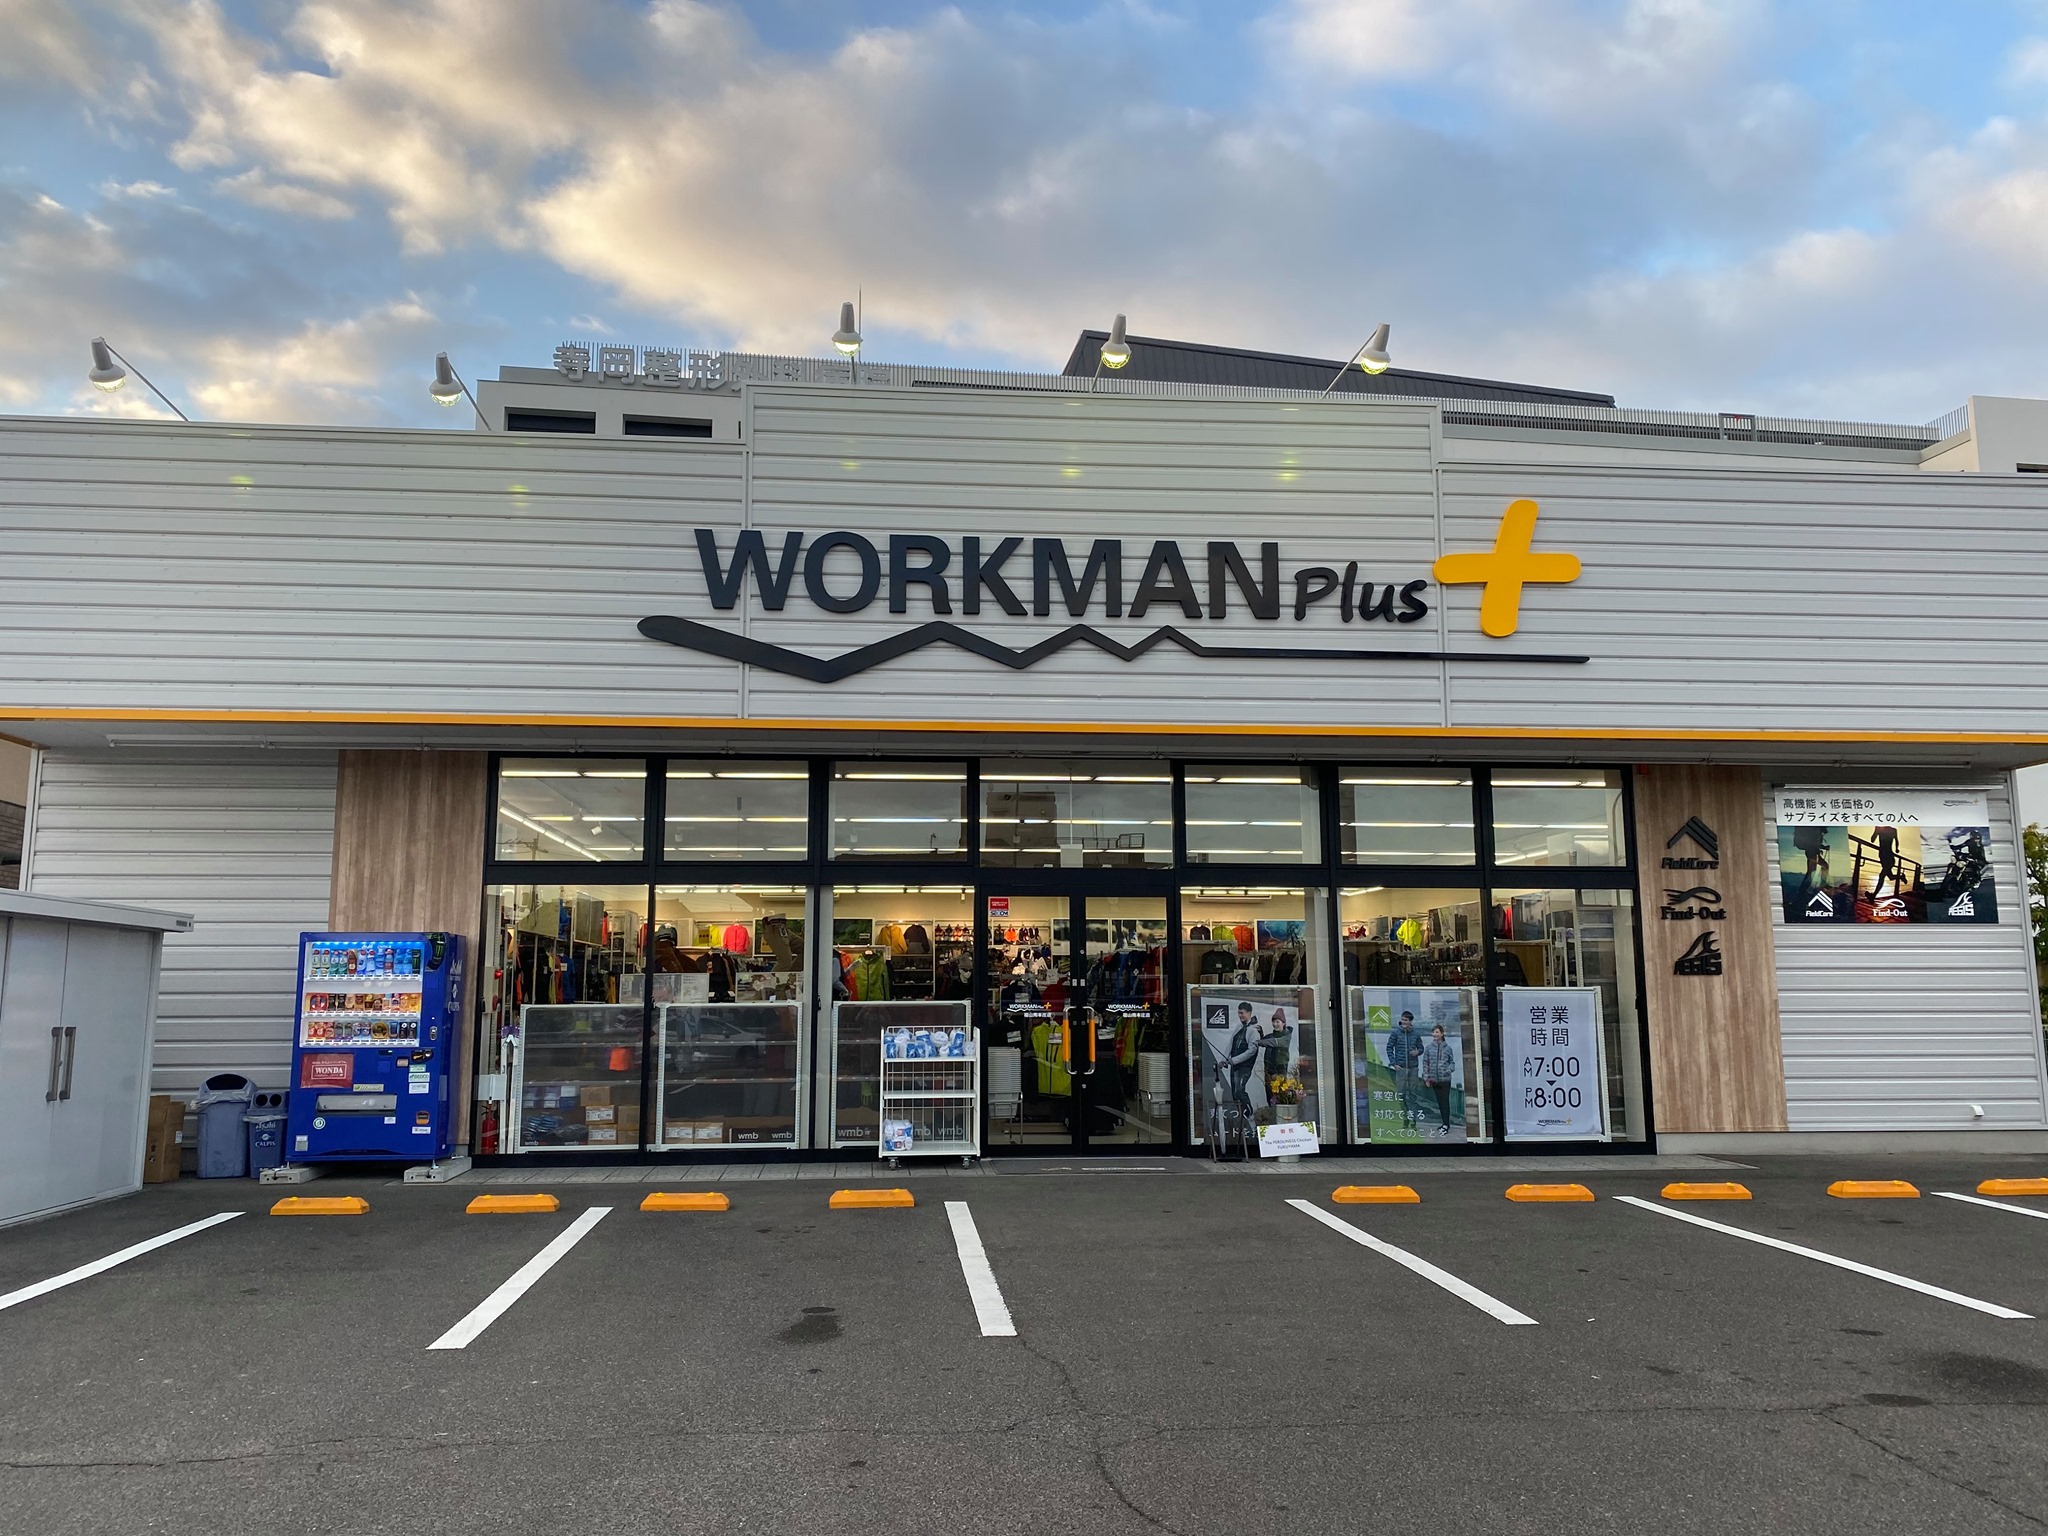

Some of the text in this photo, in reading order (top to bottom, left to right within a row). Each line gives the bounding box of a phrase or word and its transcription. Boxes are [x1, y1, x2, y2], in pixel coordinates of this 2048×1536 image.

[694, 528, 1280, 620] WORKMAN
[1784, 812, 1919, 823] サプライズをすべての人へ
[1661, 857, 1719, 870] FieldCore
[1660, 905, 1727, 920] Find-Out
[1873, 909, 1908, 917] Find-Out
[1530, 1005, 1569, 1024] 営業
[1531, 1027, 1569, 1046] 時間
[315, 1066, 343, 1074] WONDA
[1534, 1056, 1580, 1077] 7:00
[1373, 1090, 1404, 1101] 寒空に
[1534, 1087, 1582, 1108] 8:00
[1374, 1109, 1425, 1120] 対応できる
[737, 1132, 759, 1140] wmb
[771, 1131, 793, 1139] wmb
[837, 1125, 864, 1137] wmb
[914, 1125, 931, 1136] mb
[937, 1125, 963, 1136] wmb
[1375, 1127, 1447, 1138] すべてのことを
